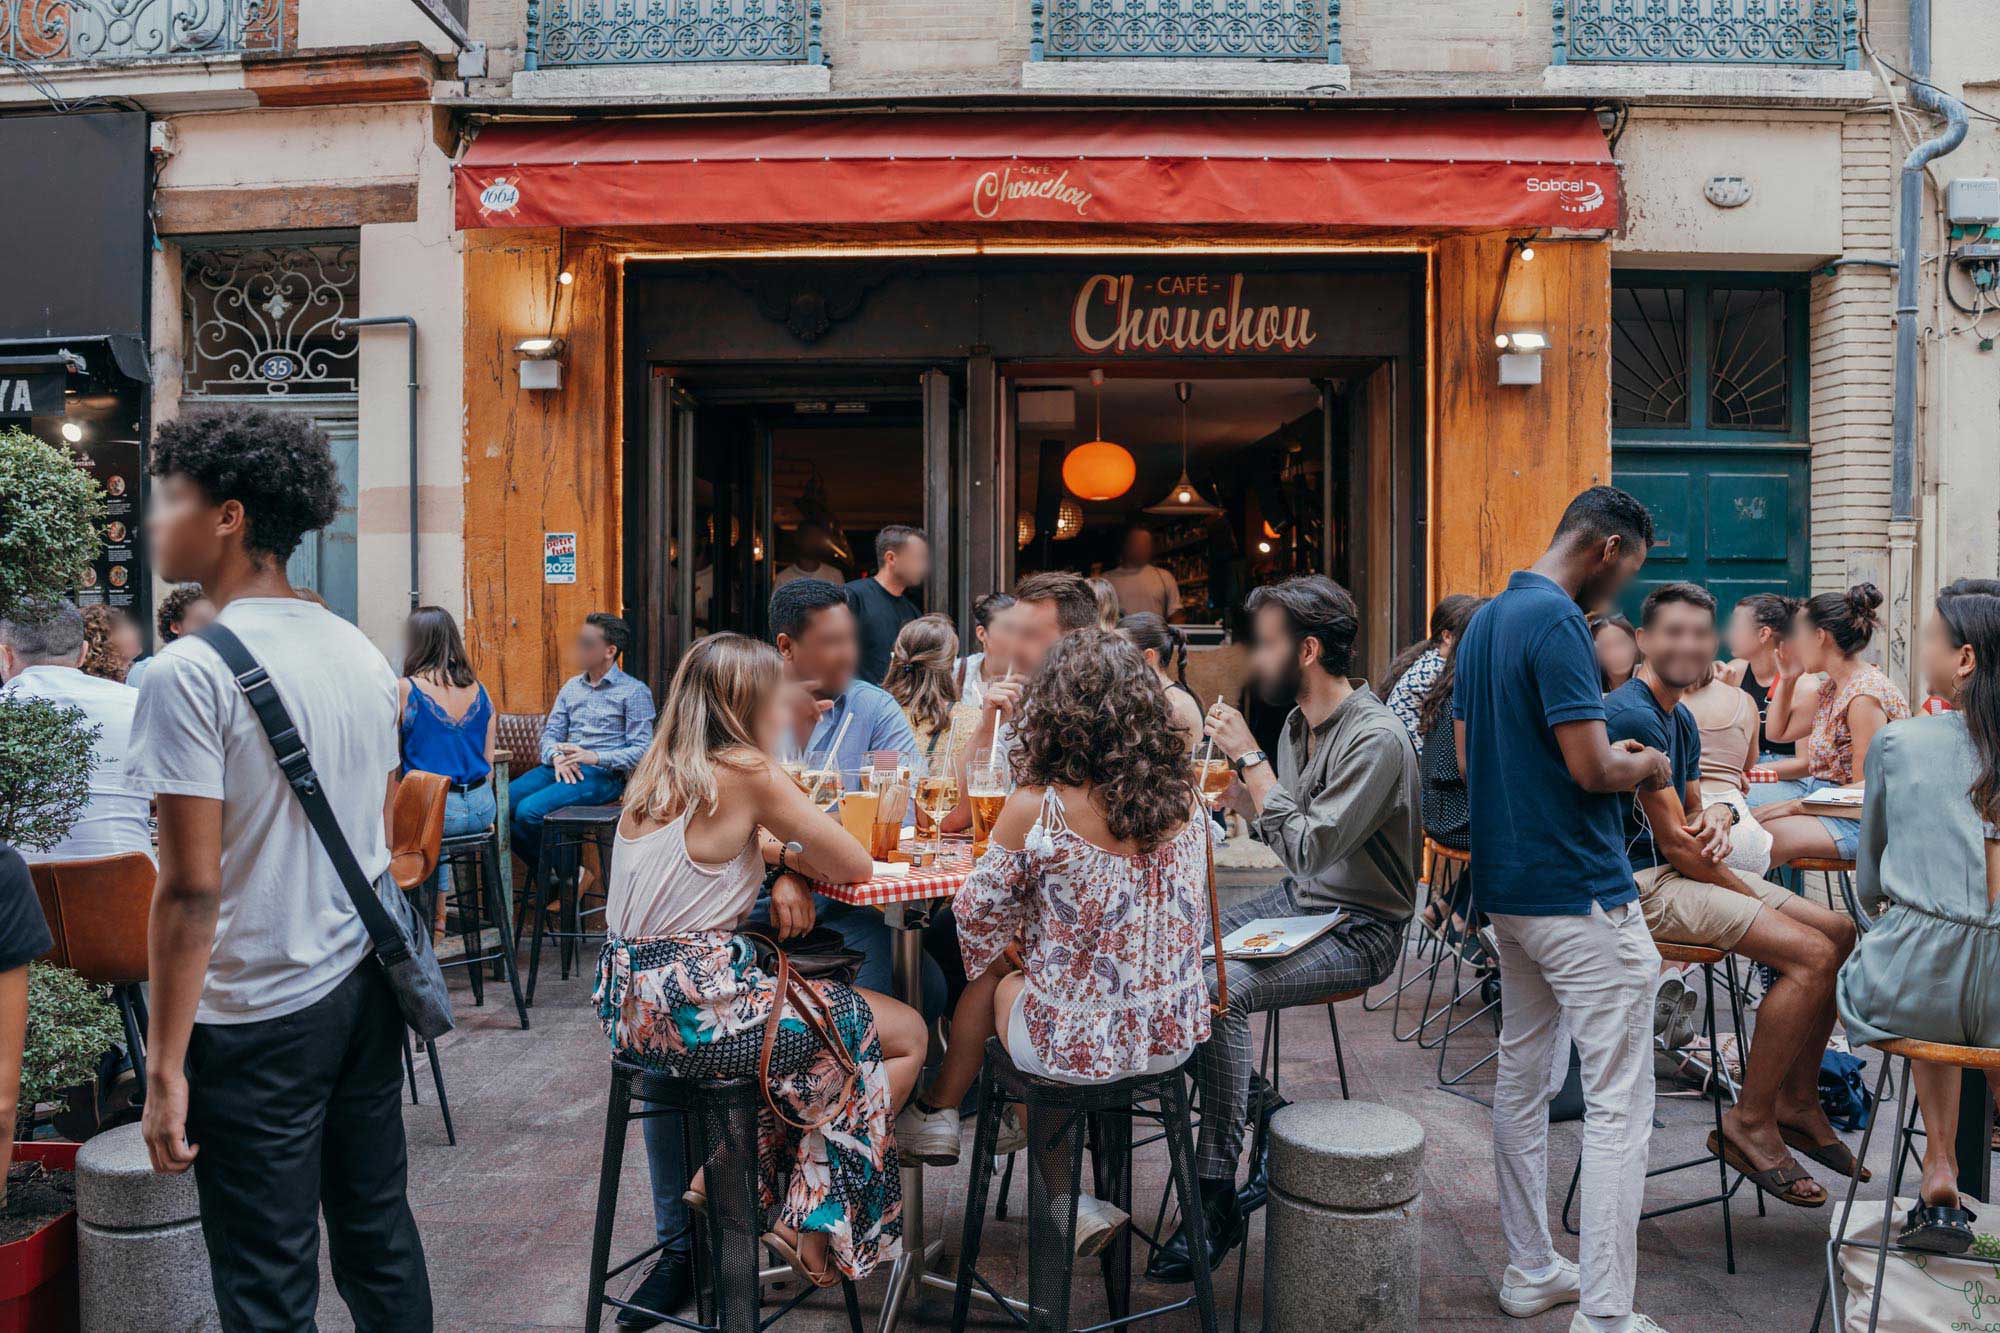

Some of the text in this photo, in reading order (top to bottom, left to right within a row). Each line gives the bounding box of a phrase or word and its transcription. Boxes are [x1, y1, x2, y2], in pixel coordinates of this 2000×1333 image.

[1526, 177, 1584, 192] Sobcal
[483, 189, 517, 204] 1664
[973, 167, 1093, 219] Chouchou
[1157, 274, 1209, 295] CAFÉ
[1071, 273, 1317, 353] Chouchou
[267, 360, 288, 376] 35
[546, 537, 572, 550] petit
[546, 562, 576, 573] 2022
